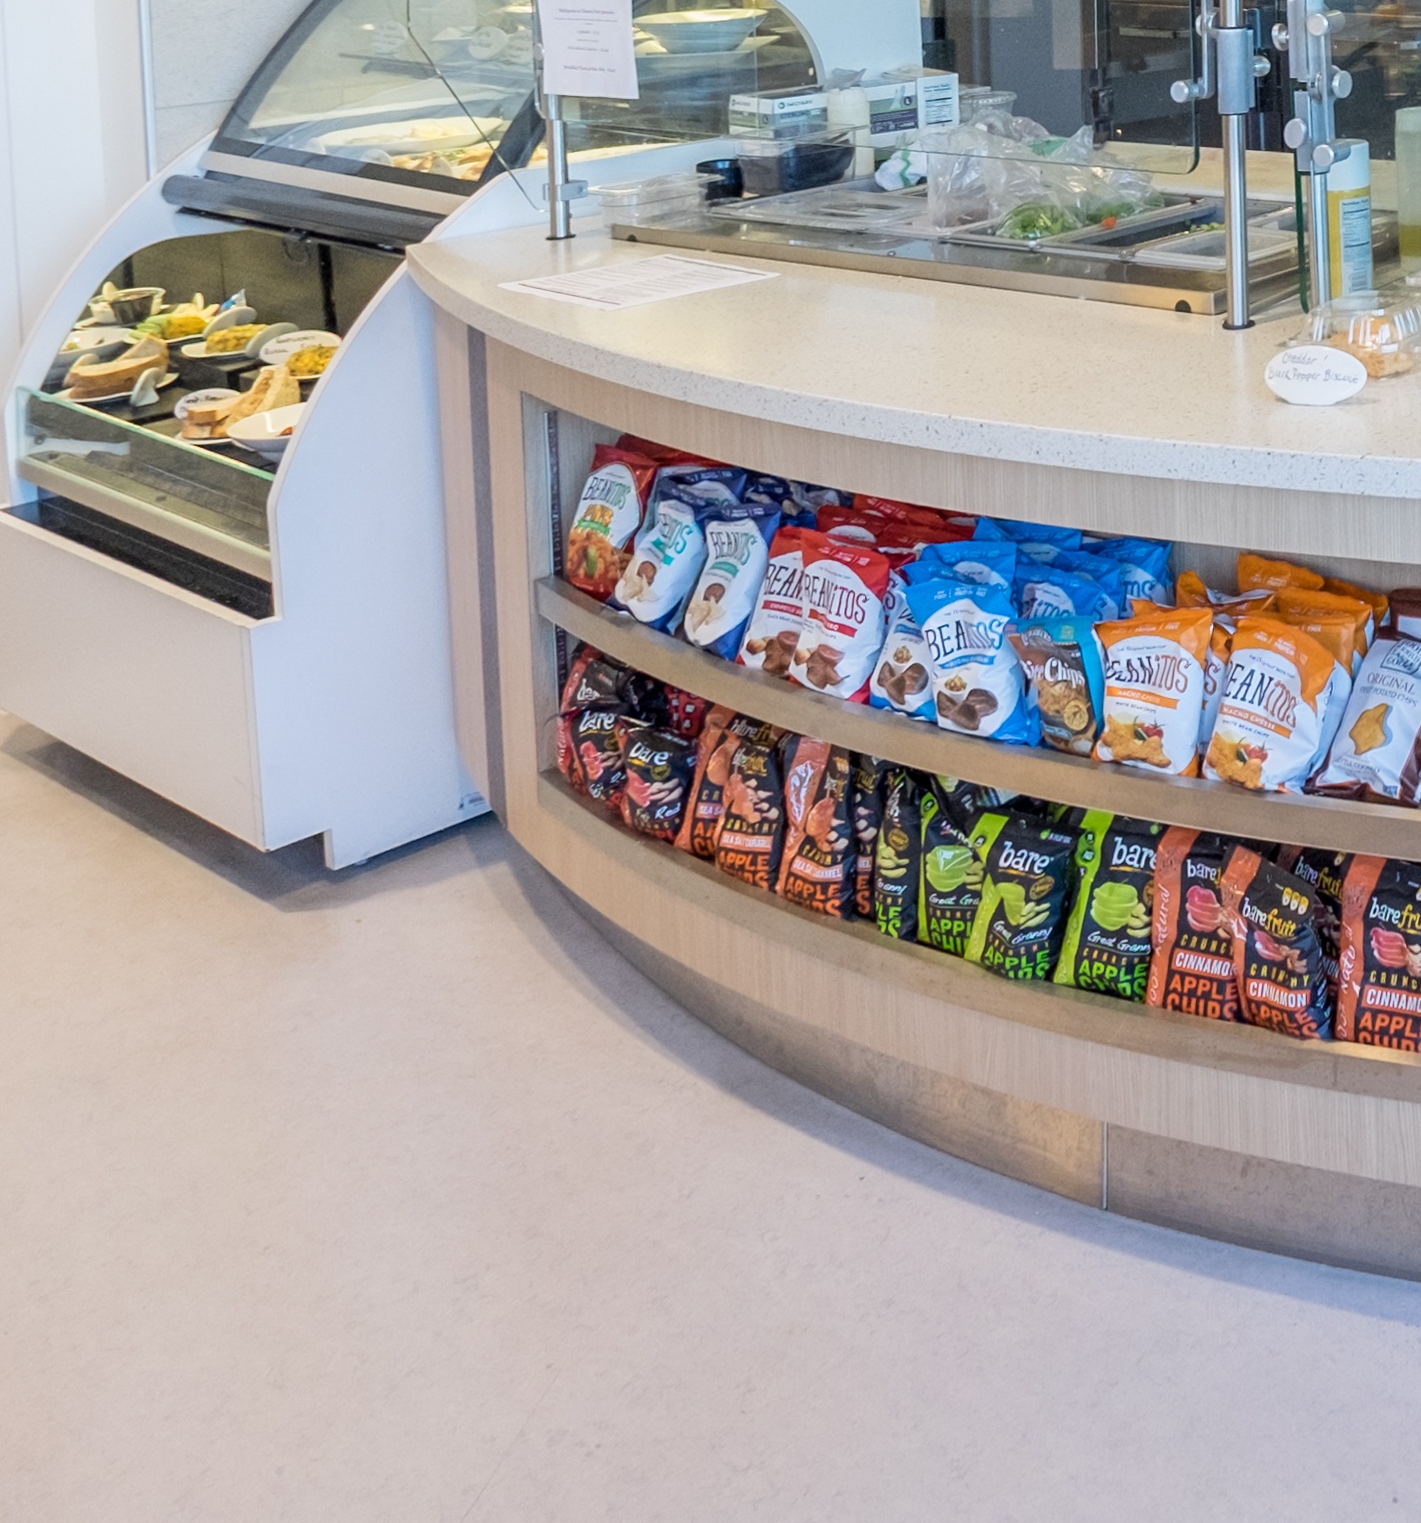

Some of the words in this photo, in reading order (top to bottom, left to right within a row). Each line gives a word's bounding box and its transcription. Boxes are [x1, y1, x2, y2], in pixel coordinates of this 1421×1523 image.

[1044, 656, 1086, 689] Chips
[1367, 673, 1417, 695] ORIGINAL
[1118, 690, 1141, 700] NACHO
[1223, 707, 1250, 720] NACHO
[1250, 715, 1276, 730] CHEESE
[719, 851, 769, 870] APPLE
[998, 841, 1049, 873] bare
[787, 877, 842, 900] APPLE
[1242, 897, 1297, 938] barefruit
[1087, 931, 1115, 947] Great
[985, 946, 1050, 968] APPLE
[1079, 960, 1148, 981] APPLE
[1169, 974, 1238, 999] APPLE
[1249, 981, 1307, 1006] CINNAMON
